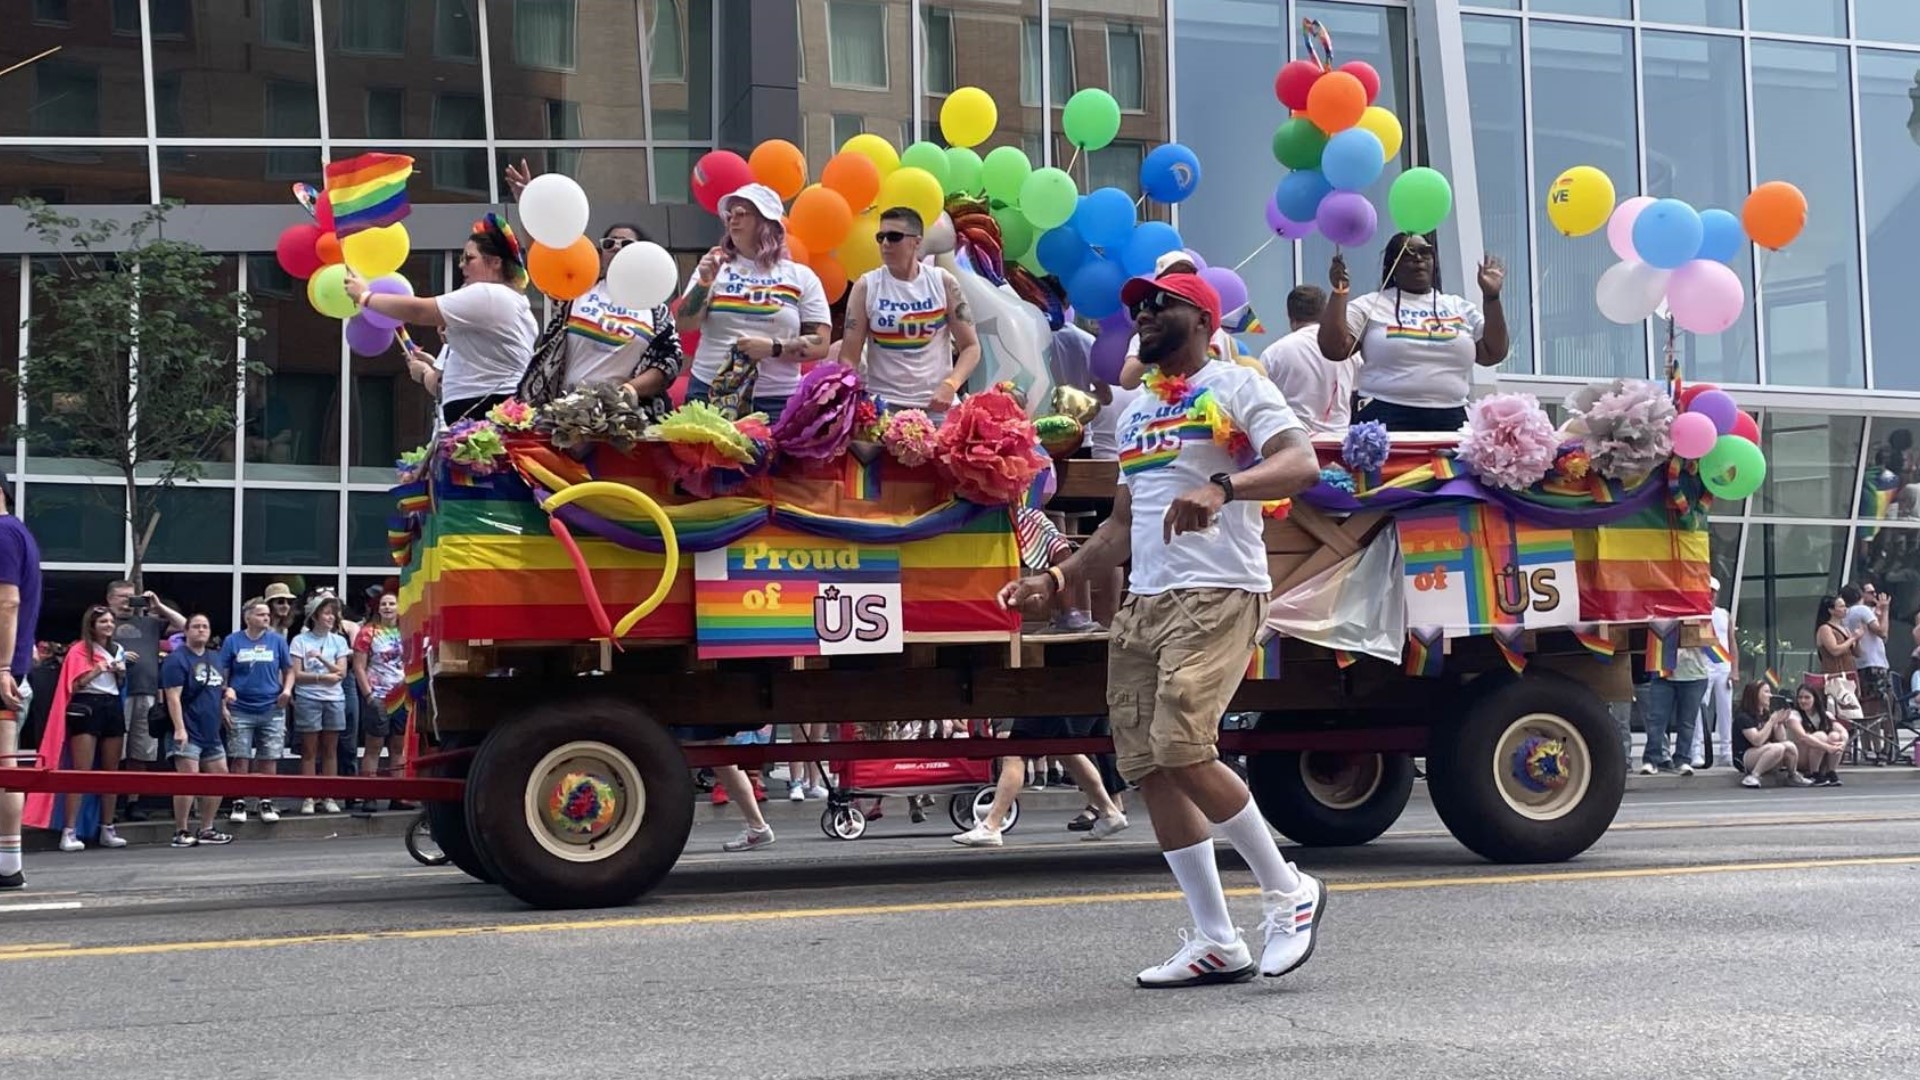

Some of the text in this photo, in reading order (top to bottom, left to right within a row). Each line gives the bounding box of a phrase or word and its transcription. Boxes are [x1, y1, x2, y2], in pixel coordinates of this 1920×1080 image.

[726, 283, 744, 294] of
[879, 297, 933, 312] Proud
[878, 315, 937, 339] of US
[1141, 430, 1181, 454] US
[742, 542, 861, 570] Proud
[1414, 565, 1560, 614] of US
[742, 582, 889, 643] of US
